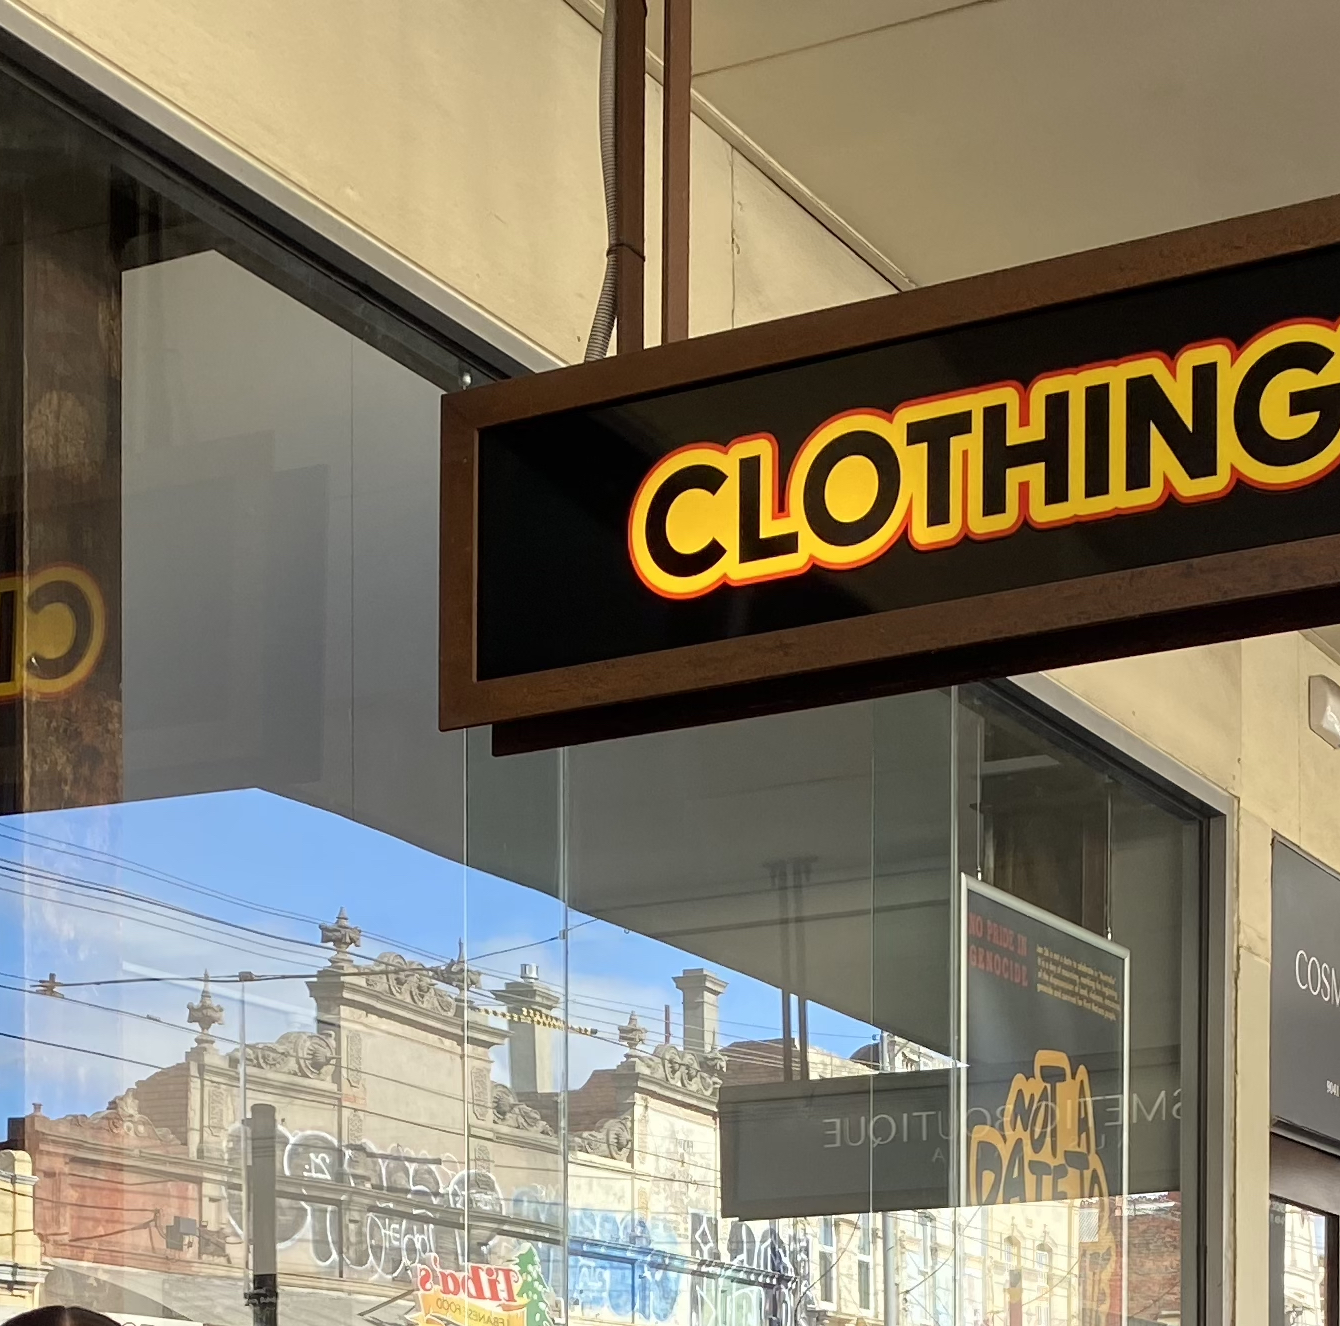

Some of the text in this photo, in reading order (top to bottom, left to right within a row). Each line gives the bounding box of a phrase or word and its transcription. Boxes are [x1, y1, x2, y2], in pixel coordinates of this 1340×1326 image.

[969, 913, 984, 938] NO
[987, 919, 1015, 951] PRIDE
[968, 944, 1029, 987] GENOCIDE
